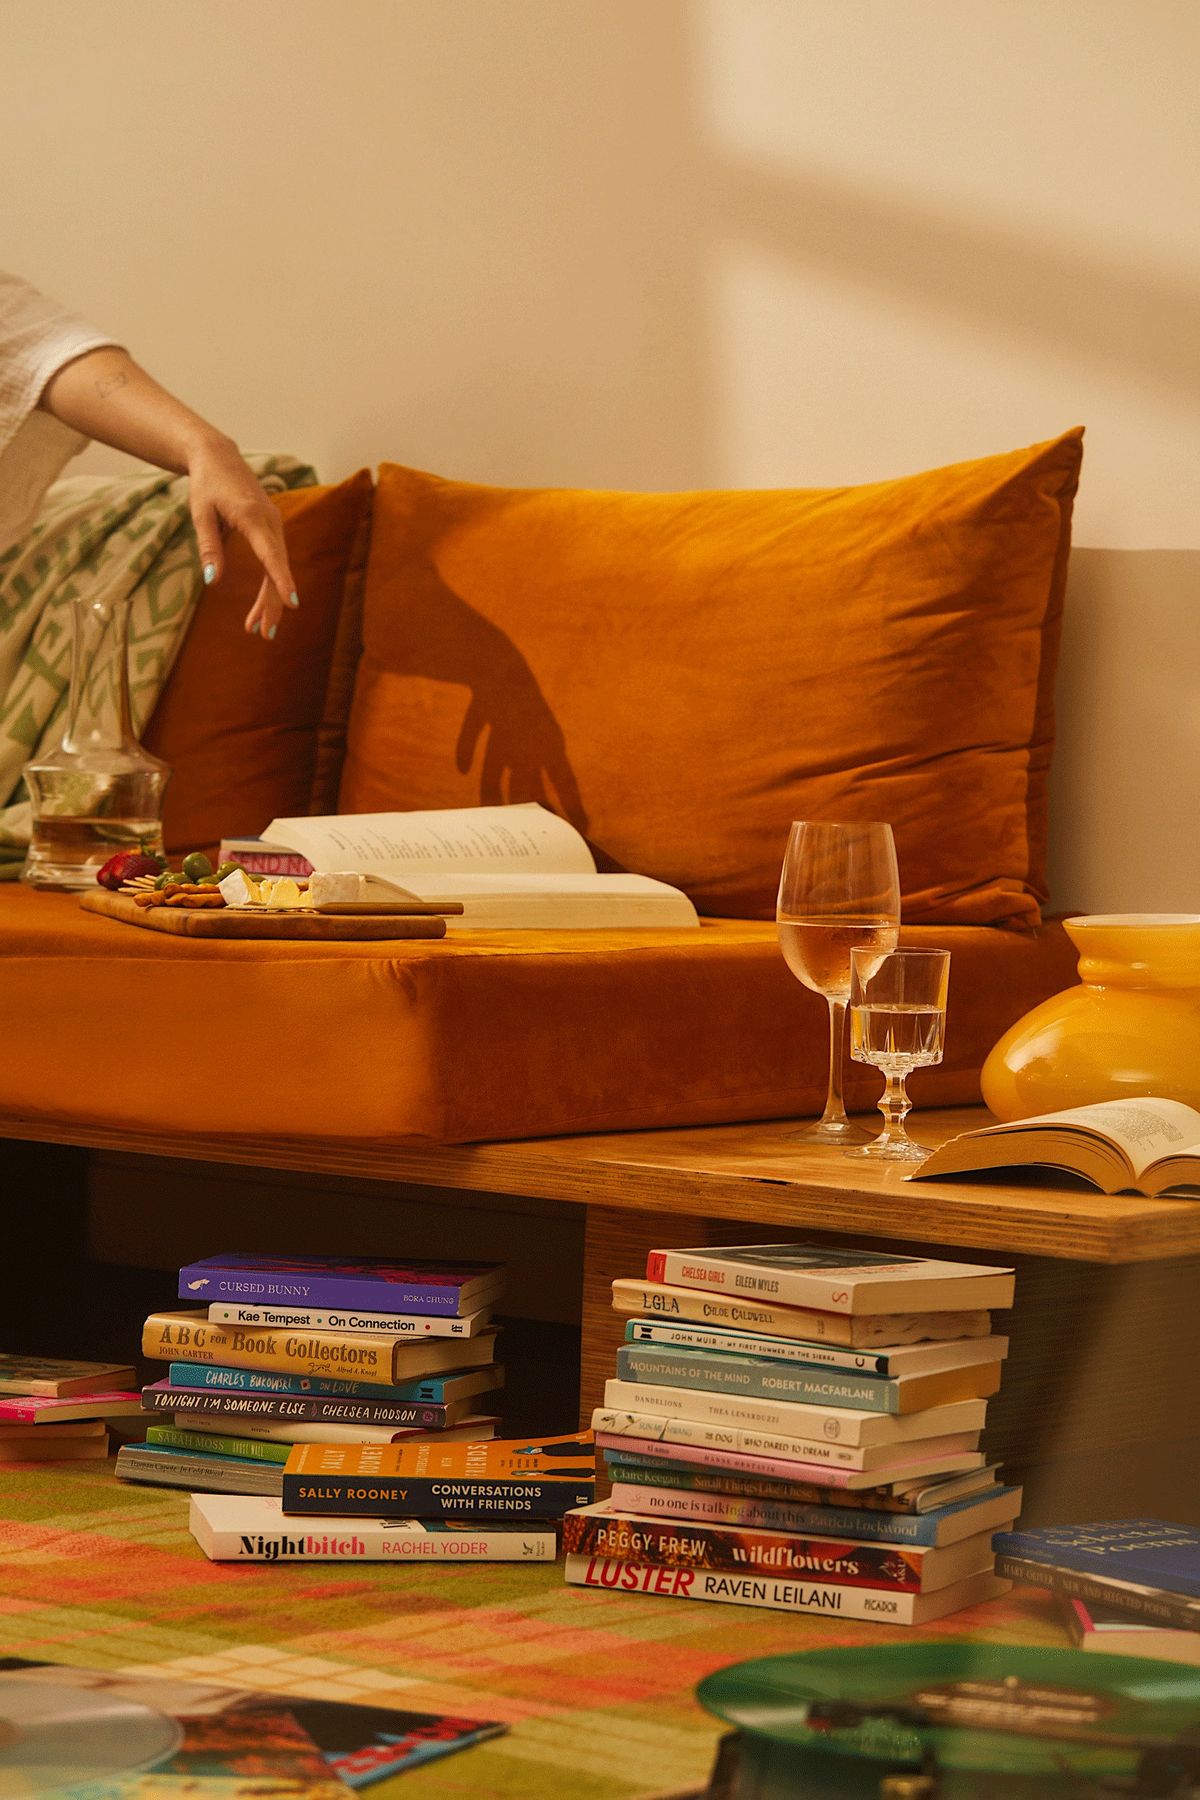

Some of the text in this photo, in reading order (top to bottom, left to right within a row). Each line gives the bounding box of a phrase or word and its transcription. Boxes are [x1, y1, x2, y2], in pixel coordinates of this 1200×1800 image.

[681, 1265, 725, 1284] CHELSEA GIRLS
[735, 1274, 780, 1293] EILEEN MYLES
[219, 1281, 310, 1296] CURSED BUNNY
[403, 1294, 454, 1304] BORA CHUNG
[642, 1292, 680, 1314] LGLA
[238, 1310, 311, 1326] Kae Tempest
[328, 1315, 415, 1332] On Connection
[671, 1332, 717, 1345] JOHN MUIR
[159, 1346, 214, 1360] JOHN CARTER
[210, 1335, 227, 1345] FOR
[232, 1331, 277, 1355] Book
[285, 1336, 378, 1366] Collectors
[738, 1342, 757, 1351] FIRST
[759, 1345, 786, 1354] SUMMER
[797, 1350, 811, 1358] THE
[812, 1351, 836, 1362] SIERRA
[205, 1370, 292, 1391] CHARLES BUKOWSKI
[629, 1361, 750, 1384] MOUNTAINS OF THE MIND
[332, 1380, 360, 1394] LOVE
[761, 1377, 802, 1392] ROBERT
[804, 1383, 875, 1401] MACFARLANE
[154, 1393, 306, 1415] TONIGHT I'M SOMEONE ELSE
[634, 1395, 683, 1409] DANDELIONS
[709, 1406, 729, 1416] THEA
[322, 1403, 417, 1422] CHELSEA HODSON
[157, 1431, 225, 1451] SARAH MOSS
[715, 1433, 733, 1443] DOG
[763, 1441, 789, 1451] DARED
[791, 1444, 801, 1453] TO
[802, 1446, 830, 1458] DREAM
[612, 1468, 681, 1486] Claire Keegan
[695, 1475, 721, 1489] Small
[725, 1479, 758, 1496] Things
[298, 1487, 408, 1500] SALLY ROONEY
[431, 1484, 542, 1497] CONVERSATIONS
[441, 1499, 532, 1511] WITH FRIENDS
[649, 1496, 805, 1523] no one is talking about this
[810, 1511, 918, 1537] Patricia Lockwood
[238, 1534, 366, 1560] Nightbitch
[382, 1541, 488, 1556] RACHEL YODER
[597, 1528, 706, 1557] PEGGY FREW
[732, 1544, 860, 1575] wildflowers
[585, 1557, 696, 1597] LUSTER
[704, 1576, 841, 1610] RAVEN LEILANI
[863, 1599, 898, 1614] PICADOR
